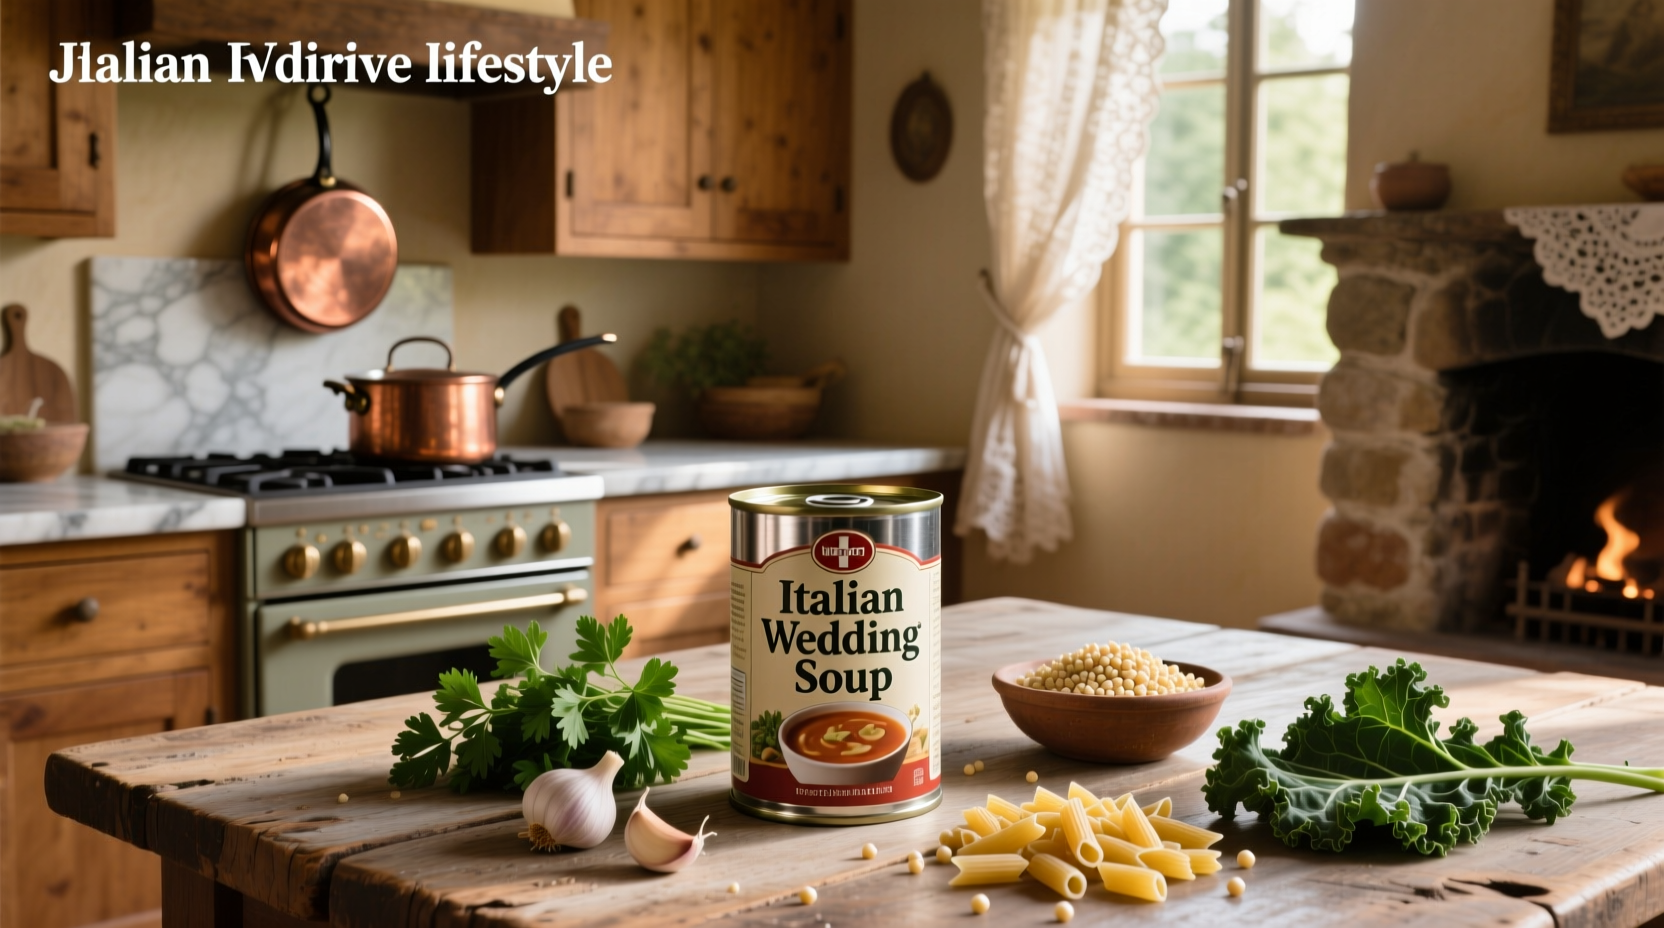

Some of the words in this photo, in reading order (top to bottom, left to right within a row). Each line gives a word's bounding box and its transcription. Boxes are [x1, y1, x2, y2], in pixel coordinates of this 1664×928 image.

[779, 579, 904, 616] Italian
[761, 618, 920, 661] Wedding
[795, 658, 893, 701] Soup
